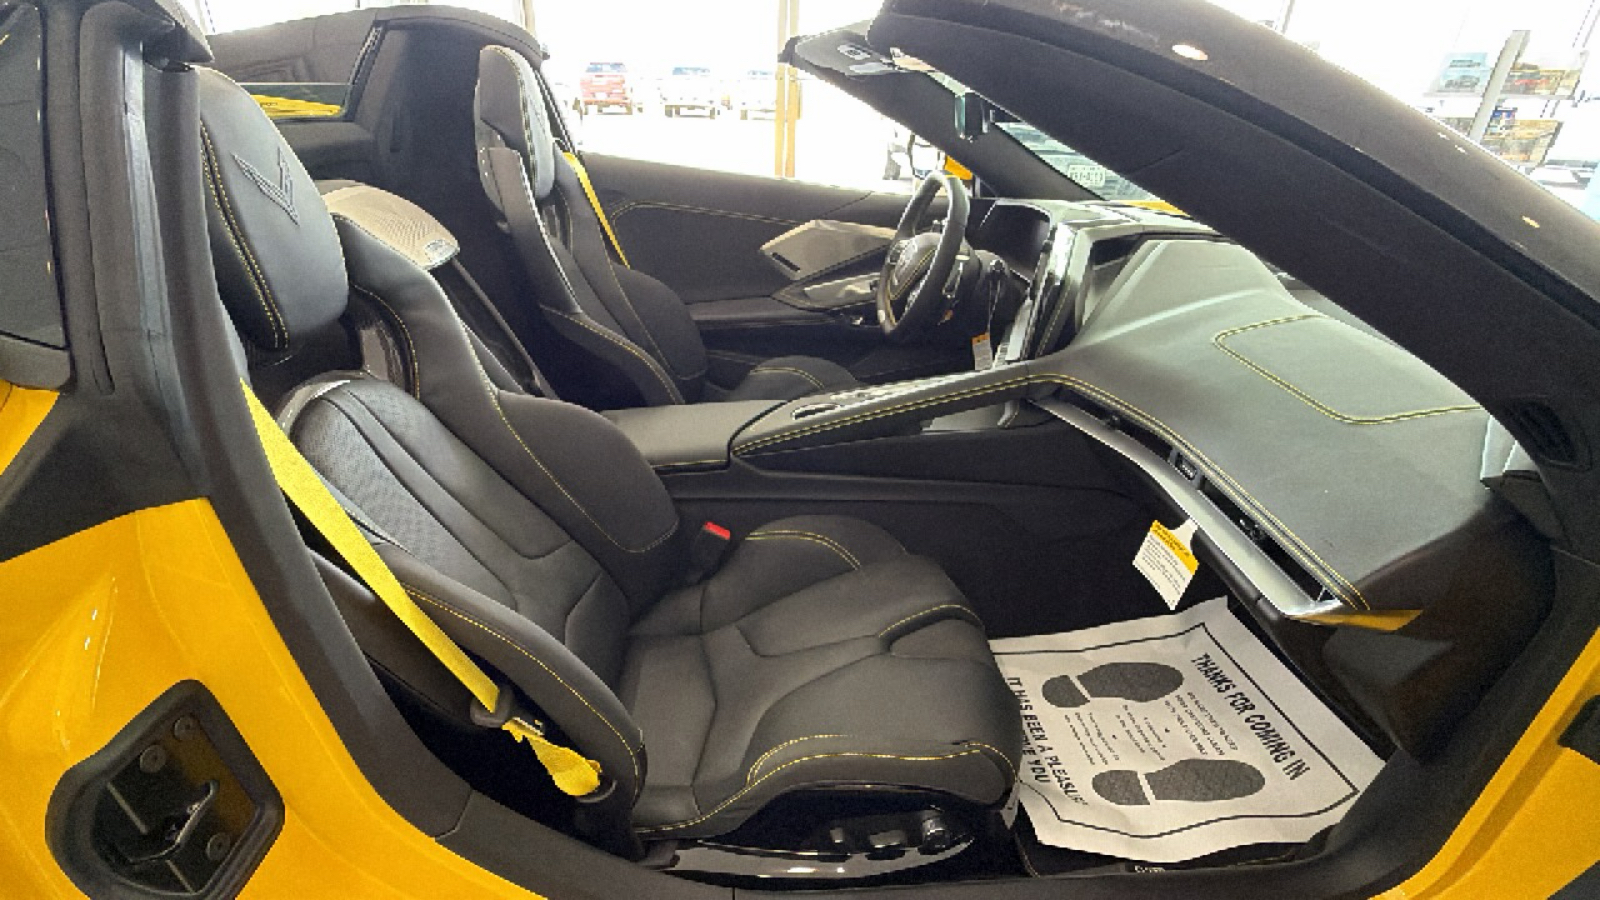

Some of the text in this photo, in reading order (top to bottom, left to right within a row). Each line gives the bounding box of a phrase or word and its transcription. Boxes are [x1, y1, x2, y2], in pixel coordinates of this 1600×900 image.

[1006, 677, 1022, 687] IT
[1022, 714, 1049, 741] BEEN
[1036, 744, 1053, 754] A
[1191, 652, 1237, 693] THANKS
[1224, 691, 1256, 715] FOR
[1244, 714, 1296, 763] COMING
[1282, 758, 1311, 781] IN
[1027, 759, 1051, 783] YOU
